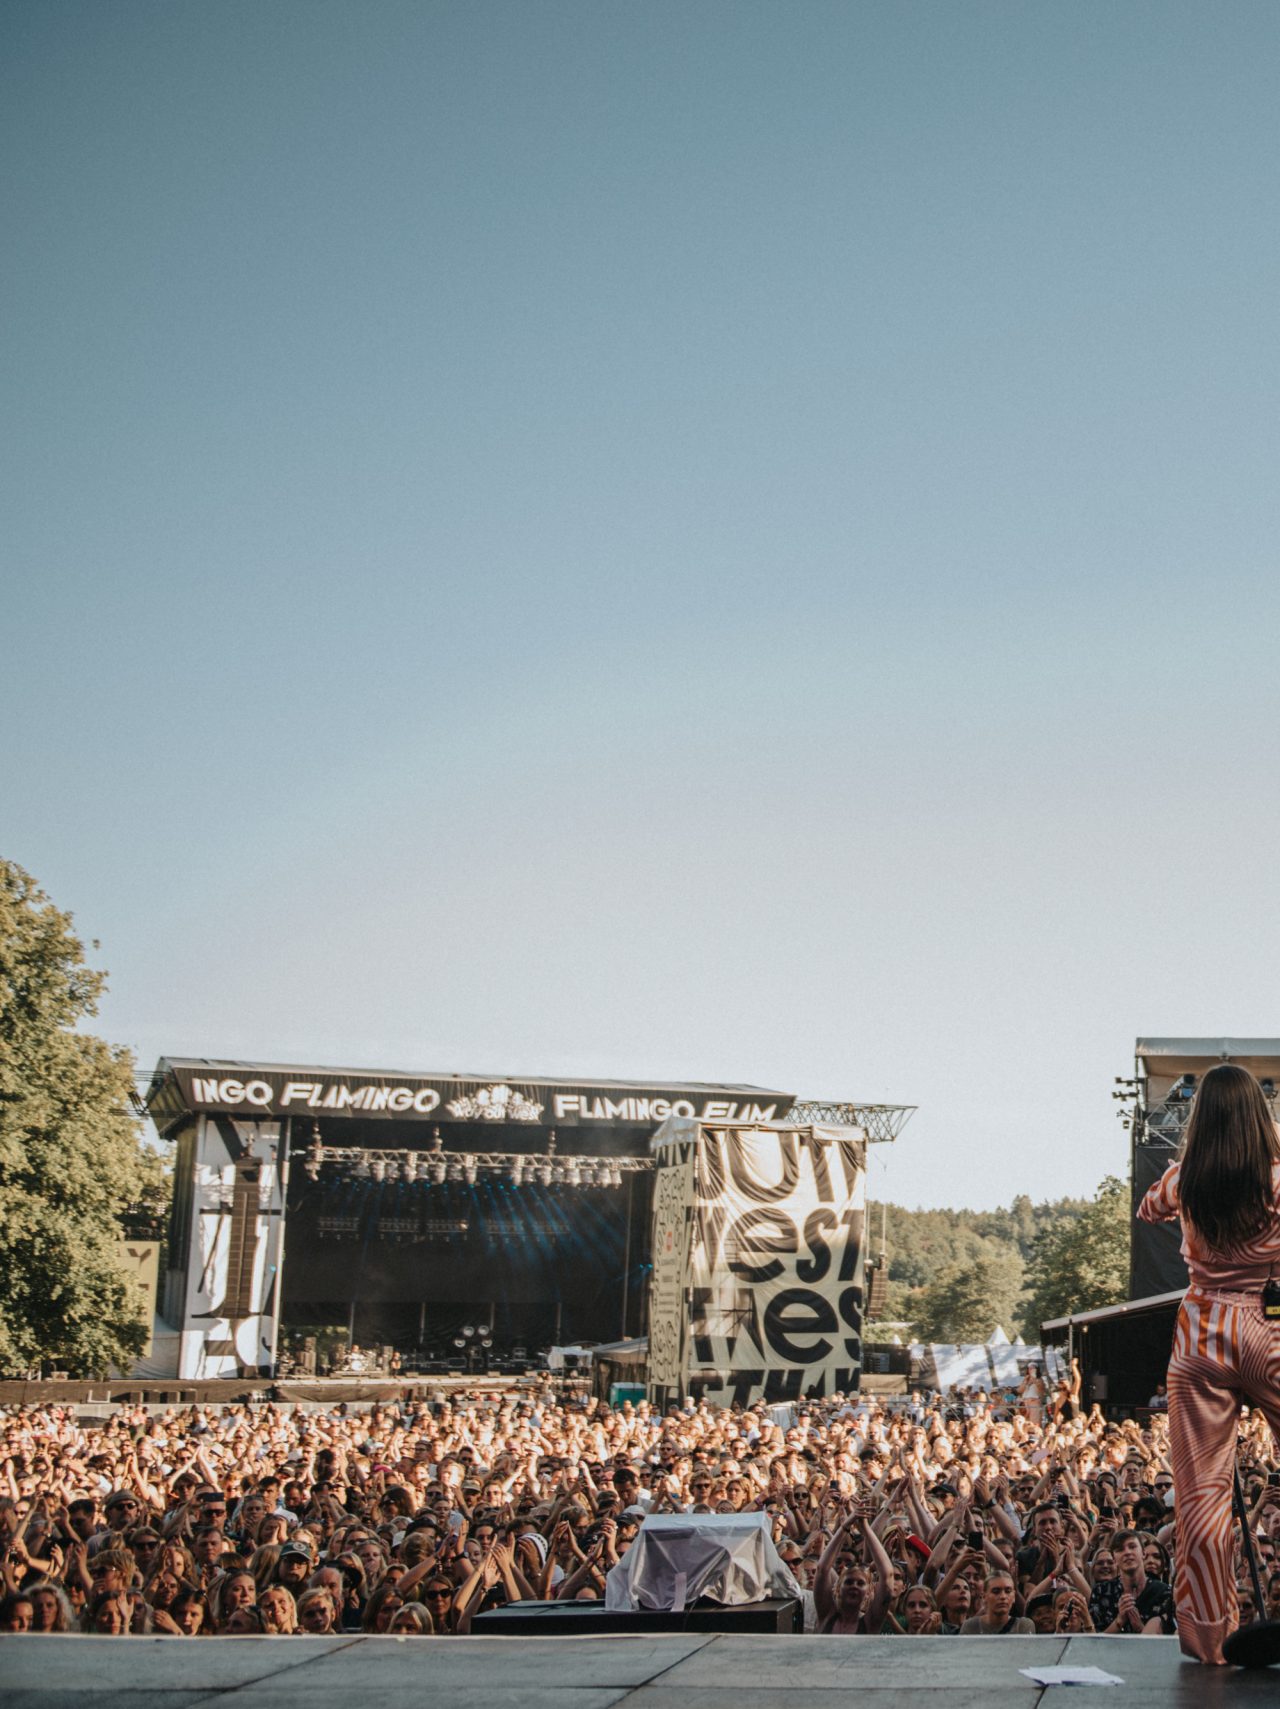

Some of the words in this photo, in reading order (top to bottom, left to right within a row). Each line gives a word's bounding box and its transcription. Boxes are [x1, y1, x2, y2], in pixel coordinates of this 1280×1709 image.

[192, 1078, 274, 1106] INGO
[280, 1082, 440, 1113] FLAMINGO
[553, 1094, 696, 1121] FLAMINGO
